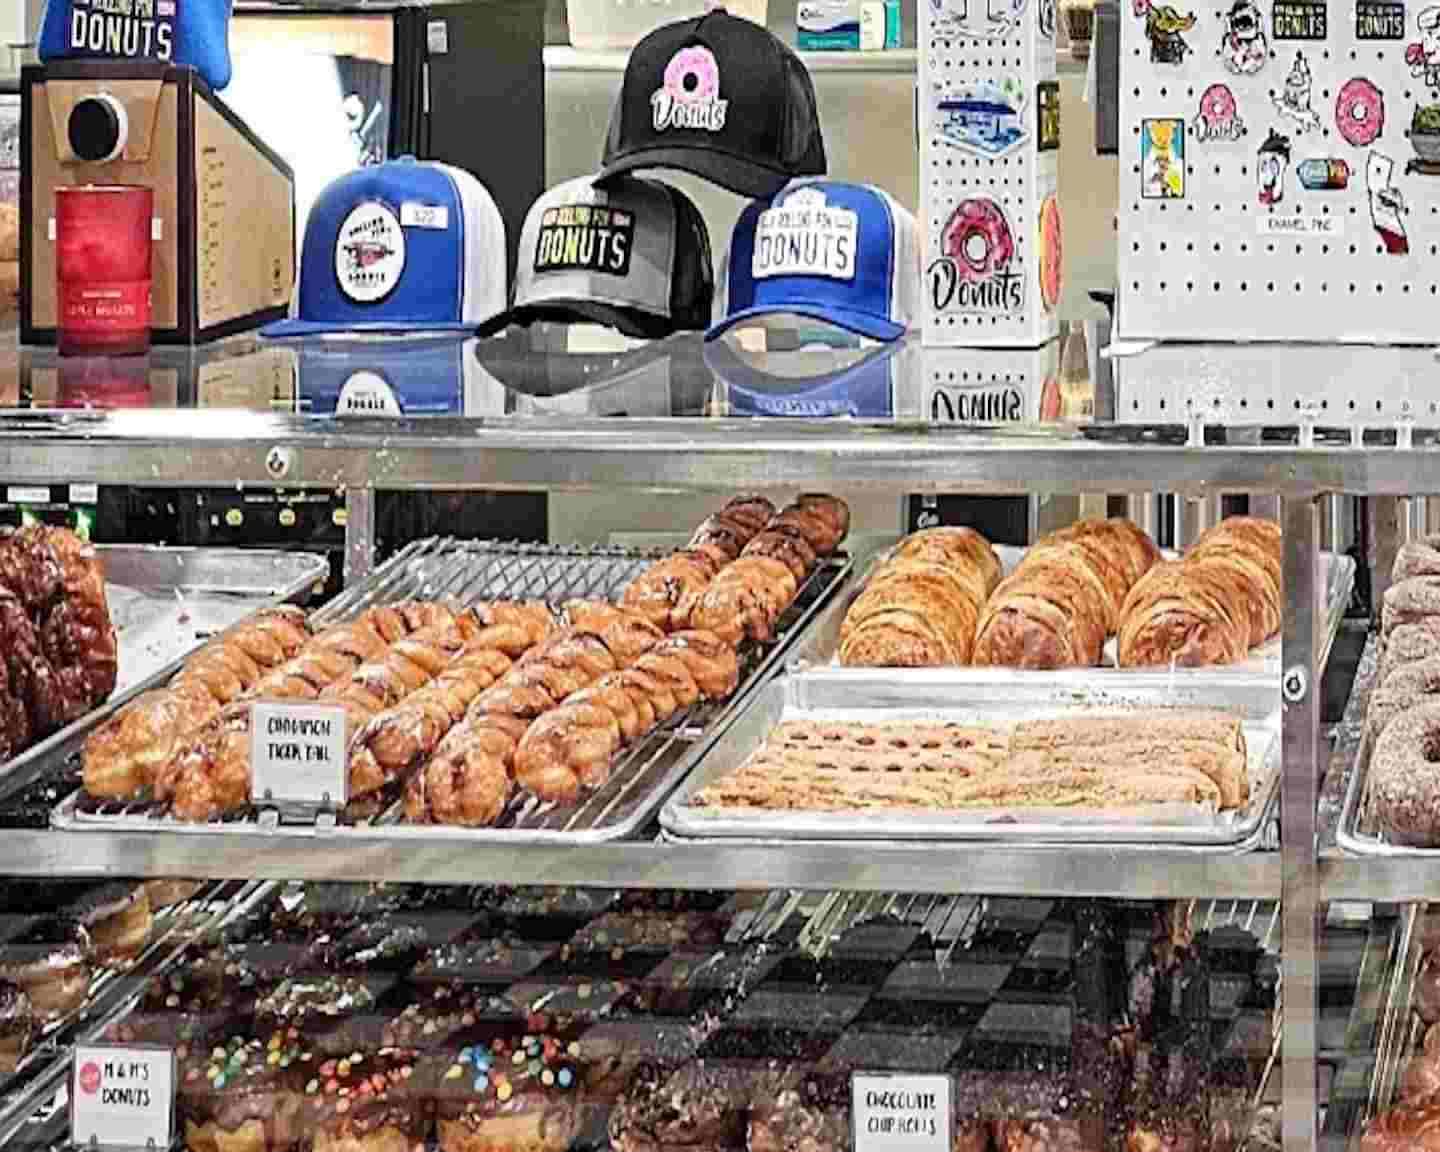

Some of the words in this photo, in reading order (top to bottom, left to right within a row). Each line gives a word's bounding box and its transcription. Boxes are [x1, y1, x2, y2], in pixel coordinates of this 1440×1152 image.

[71, 9, 172, 60] DONUTS
[537, 226, 627, 269] DONUTS
[760, 232, 850, 270] DONUTS
[927, 258, 1024, 310] Donuts
[102, 1088, 151, 1107] DONUTS
[866, 1091, 936, 1110] CHOCOLATE
